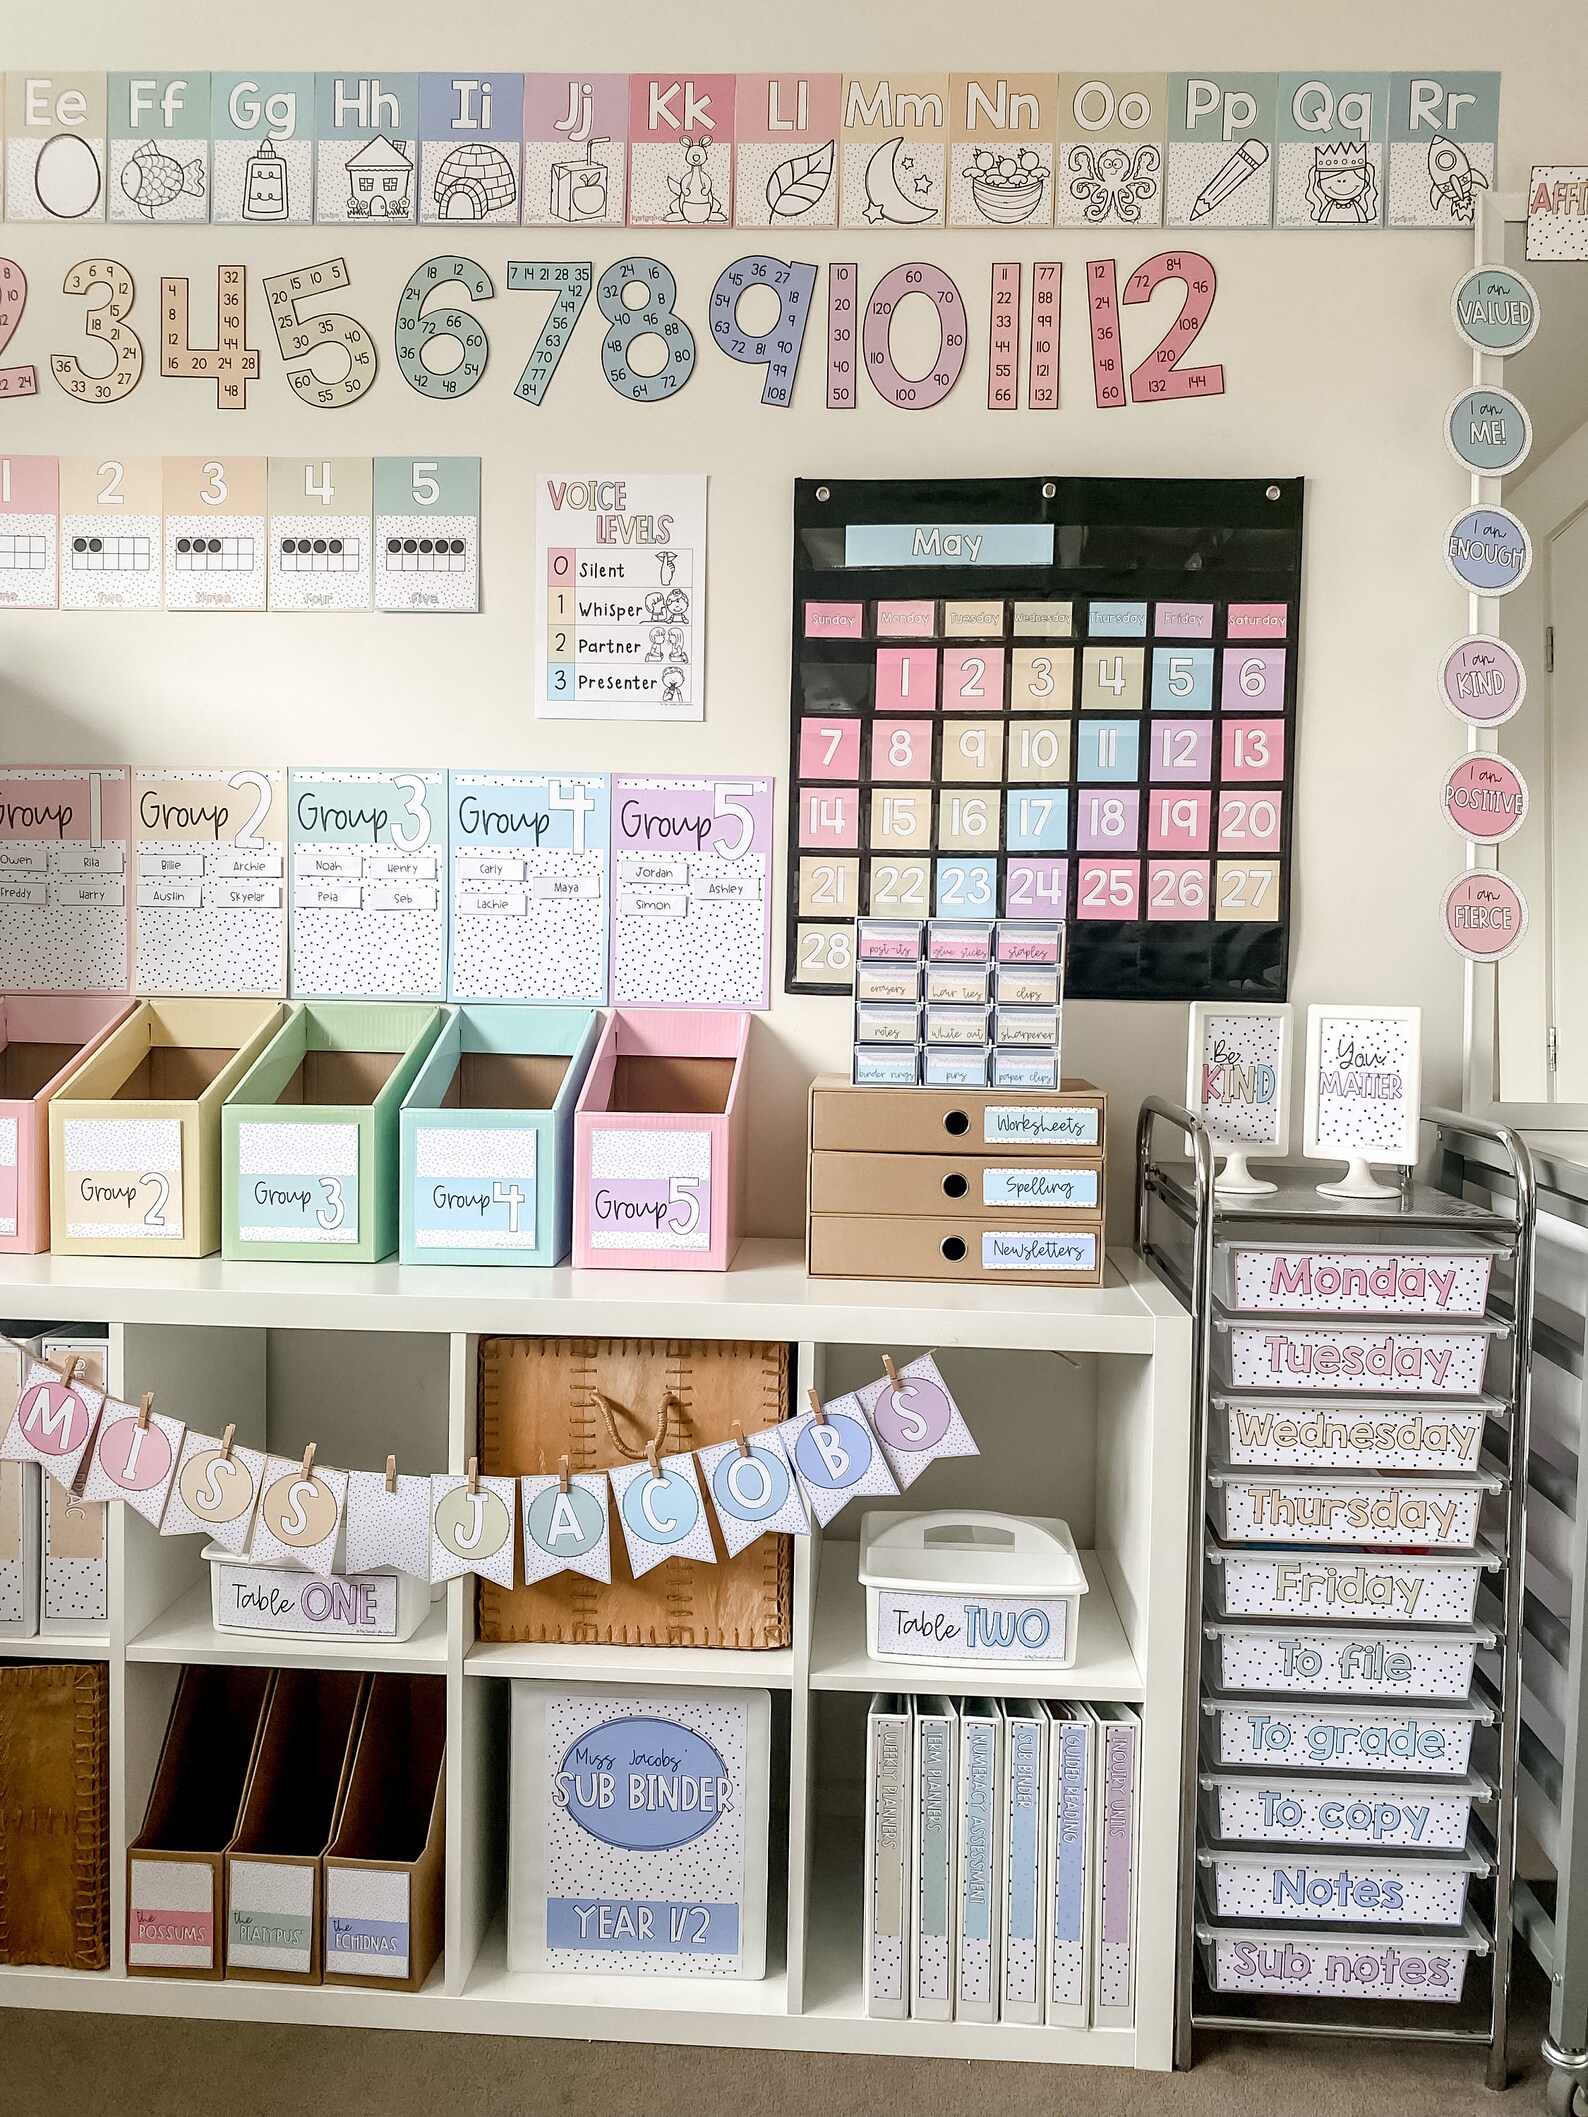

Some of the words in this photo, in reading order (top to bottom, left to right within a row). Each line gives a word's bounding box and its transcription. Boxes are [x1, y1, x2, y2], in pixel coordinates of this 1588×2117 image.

[24, 78, 87, 126] Ee
[129, 79, 189, 127] Ff
[228, 81, 297, 139] Gg
[333, 79, 400, 128] Hh
[450, 80, 493, 129] Ii
[553, 81, 594, 141] Jj
[647, 80, 717, 131] Kk
[768, 80, 808, 131] Ll
[844, 80, 944, 128] Mm
[966, 79, 1040, 129] Nn
[1072, 79, 1152, 131] Oo
[1184, 79, 1258, 141] Pp
[1291, 80, 1373, 142] Qq
[1408, 79, 1478, 131] Rr
[223, 270, 239, 284] 32
[1165, 257, 1182, 271] 84
[1192, 280, 1209, 294] 96
[1487, 283, 1511, 297] am
[395, 255, 495, 399] 6
[596, 256, 697, 402] 8
[1086, 250, 1226, 408] 12
[1178, 318, 1199, 331] 108
[1458, 300, 1533, 327] VALUED
[894, 388, 917, 401] 100
[1187, 375, 1207, 388] 144
[1481, 404, 1503, 416] am
[1470, 420, 1507, 446] ME!
[547, 480, 627, 511] VOICE
[596, 514, 674, 544] LEVELS
[1482, 523, 1507, 538] am
[912, 528, 983, 562] May
[1447, 536, 1524, 570] ENOUGH
[553, 556, 569, 575] 0
[579, 563, 625, 579] Silent
[558, 594, 564, 614] 1
[579, 602, 643, 621] Whisper
[811, 613, 855, 627] Sunday
[881, 612, 930, 626] Monday
[949, 611, 1000, 626] Tuesday
[1014, 612, 1071, 625] Wednesday
[1089, 611, 1145, 626] Thursday
[1164, 612, 1204, 627] Friday
[1228, 614, 1286, 628] Saturday
[555, 633, 566, 652] 2
[579, 639, 641, 654] Partner
[554, 670, 567, 690] 3
[579, 675, 658, 690] Presenter
[1456, 670, 1506, 698] KIND
[819, 729, 843, 767] 7
[1233, 729, 1271, 768] 13
[140, 791, 228, 840] Group
[228, 770, 272, 849] 2
[297, 793, 388, 843] Group
[390, 774, 431, 852] 3
[1445, 784, 1524, 816] POSITIVE
[459, 795, 550, 847] Group
[548, 779, 595, 855] 4
[621, 799, 712, 852] Group
[713, 783, 754, 860] 5
[1090, 798, 1127, 838] 18
[1220, 799, 1276, 839] 20
[161, 860, 181, 870] Billie
[233, 861, 266, 872] Archie
[315, 860, 342, 872] Noah
[479, 864, 503, 876] Carly
[635, 866, 673, 879] Jordan
[393, 893, 413, 905] Seb
[554, 882, 580, 895] Maya
[709, 883, 744, 896] Ashley
[1082, 868, 1135, 907] 25
[1477, 888, 1500, 901] am
[476, 899, 509, 911] Lachie
[636, 899, 671, 911] Simon
[1454, 905, 1512, 930] FIERCE
[869, 945, 911, 958] post-its
[1008, 946, 1048, 960] staples
[870, 984, 906, 995] erasers
[933, 986, 958, 999] hair
[963, 987, 983, 1001] ties
[1016, 987, 1042, 1001] clips
[875, 1027, 900, 1039] notes
[1001, 1028, 1054, 1042] sharpener
[1213, 1039, 1241, 1064] Be
[1338, 1039, 1387, 1070] You
[946, 1071, 967, 1082] pins
[999, 1073, 1026, 1084] paper
[1029, 1071, 1052, 1085] clips
[1201, 1063, 1276, 1104] KIND
[1319, 1071, 1403, 1100] MATTER
[997, 1114, 1085, 1136] Worksheets
[80, 1178, 137, 1208] Group
[139, 1172, 170, 1226] 2
[255, 1181, 311, 1212] Group
[316, 1176, 345, 1230] 3
[1006, 1176, 1074, 1199] Spelling
[433, 1185, 490, 1216] Group
[492, 1181, 525, 1232] 4
[595, 1189, 667, 1229] Group
[668, 1176, 700, 1235] 5
[993, 1240, 1085, 1261] Newsletters
[1269, 1257, 1456, 1307] Monday
[1265, 1335, 1452, 1386] Tuesday
[1236, 1412, 1476, 1460] Wednesday
[1248, 1488, 1457, 1538] Thursday
[232, 1583, 295, 1615] Table
[300, 1581, 376, 1625] ONE
[1276, 1564, 1423, 1614] Friday
[892, 1609, 961, 1641] Table
[964, 1605, 1049, 1648] TWO
[1278, 1641, 1322, 1677] To
[1339, 1642, 1412, 1681] file
[927, 1732, 944, 1764] TERM
[1017, 1733, 1034, 1760] SUB
[1247, 1715, 1292, 1750] To
[1307, 1721, 1445, 1761] grade
[576, 1747, 616, 1770] Miss
[882, 1732, 899, 1781] WEEKLY
[1065, 1735, 1081, 1781] GUIDED
[1111, 1737, 1128, 1795] INQUIRY
[971, 1734, 988, 1812] NUMERACY
[1016, 1764, 1033, 1809] BINDER
[552, 1771, 616, 1809] SUB
[628, 1772, 735, 1813] BINDER
[926, 1769, 942, 1832] PLANNERS
[881, 1785, 898, 1850] PLANNERS
[1063, 1786, 1079, 1844] READING
[1110, 1800, 1127, 1838] UNITS
[1258, 1792, 1302, 1827] To
[1319, 1801, 1430, 1841] copy
[969, 1816, 986, 1904] ASSESSMENT
[1272, 1869, 1404, 1909] Notes
[136, 1911, 156, 1923] the
[233, 1912, 253, 1925] the
[332, 1920, 352, 1932] the
[572, 1904, 655, 1940] YEAR
[138, 1924, 207, 1942] POSSUMS
[335, 1934, 398, 1952] ECHIDNAS
[1233, 1941, 1311, 1979] Sub
[1326, 1949, 1450, 1986] notes
